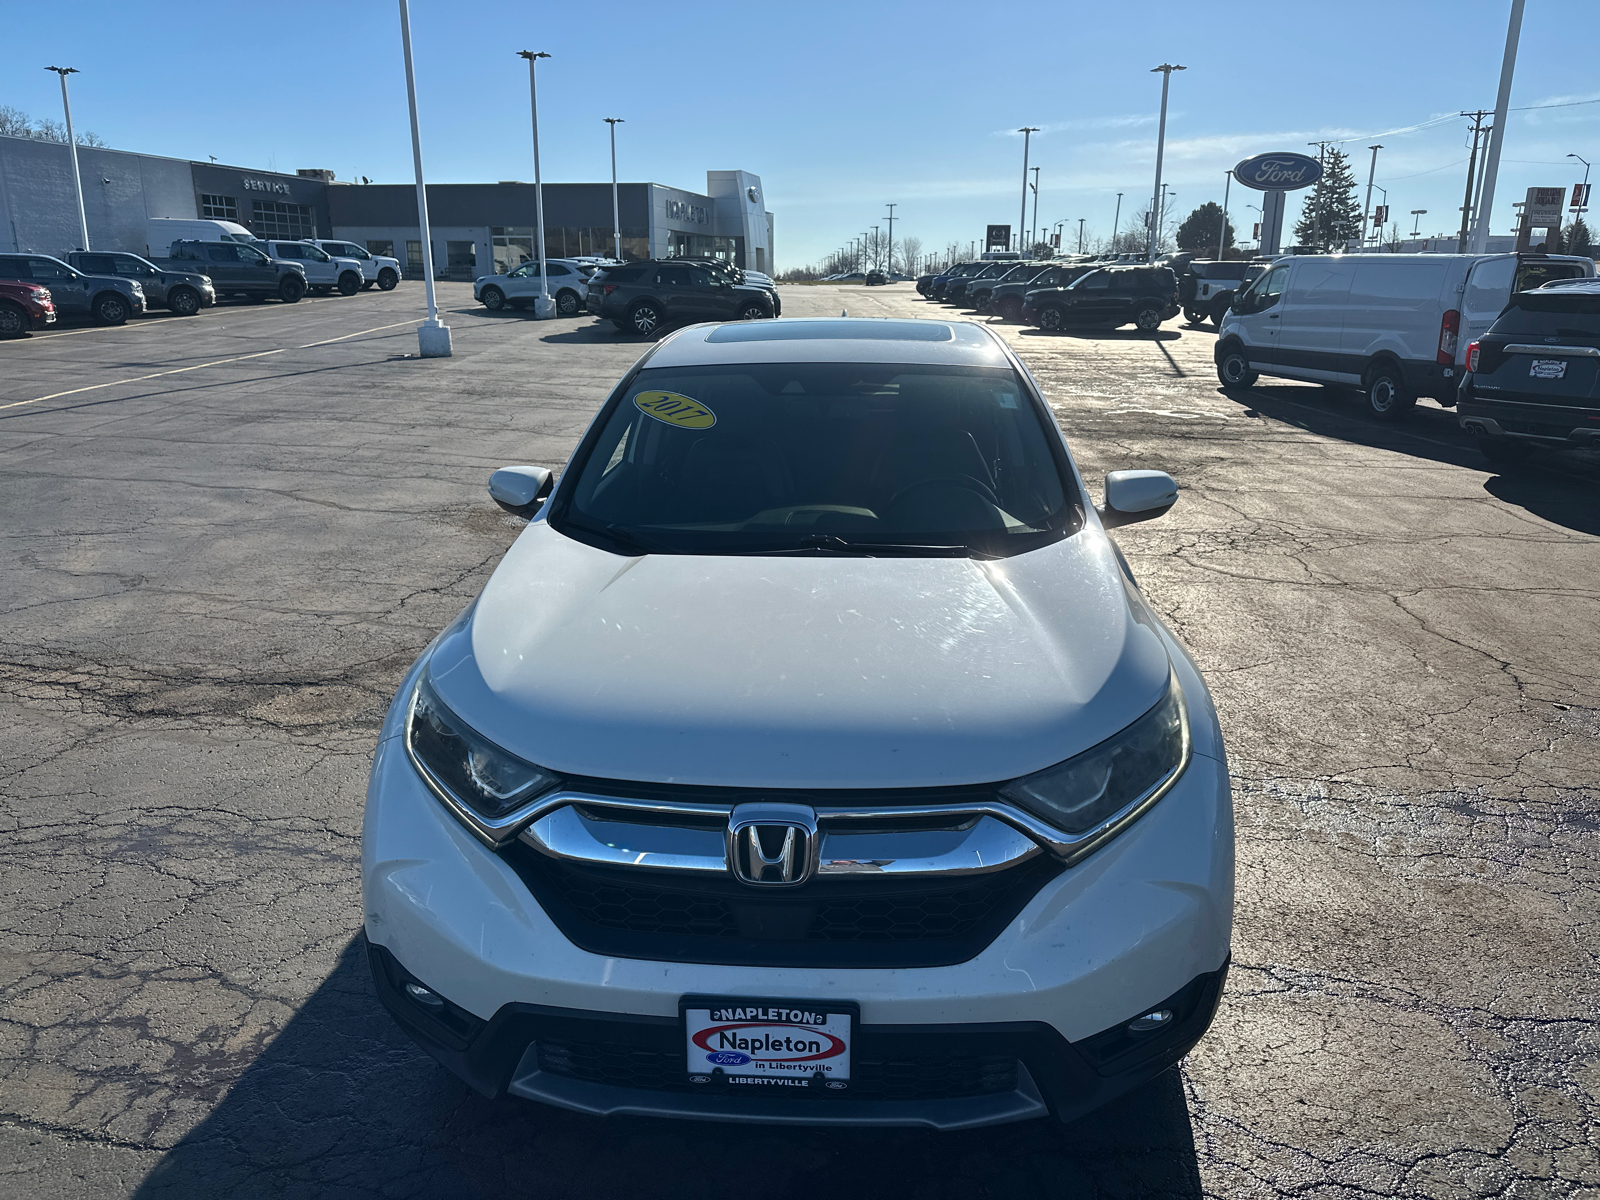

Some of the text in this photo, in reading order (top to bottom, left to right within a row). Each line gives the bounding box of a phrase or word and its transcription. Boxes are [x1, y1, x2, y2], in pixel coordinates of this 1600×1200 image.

[1255, 160, 1306, 181] Ford
[243, 178, 290, 194] SERVICE
[666, 199, 709, 225] NAPLETON
[640, 396, 709, 420] 2017
[719, 1008, 815, 1024] NAPLETON
[719, 1031, 821, 1055] Napleton
[715, 1053, 742, 1064] Ford
[755, 1062, 832, 1072] in Libertyville
[728, 1077, 809, 1087] LIBERTYVILLE
